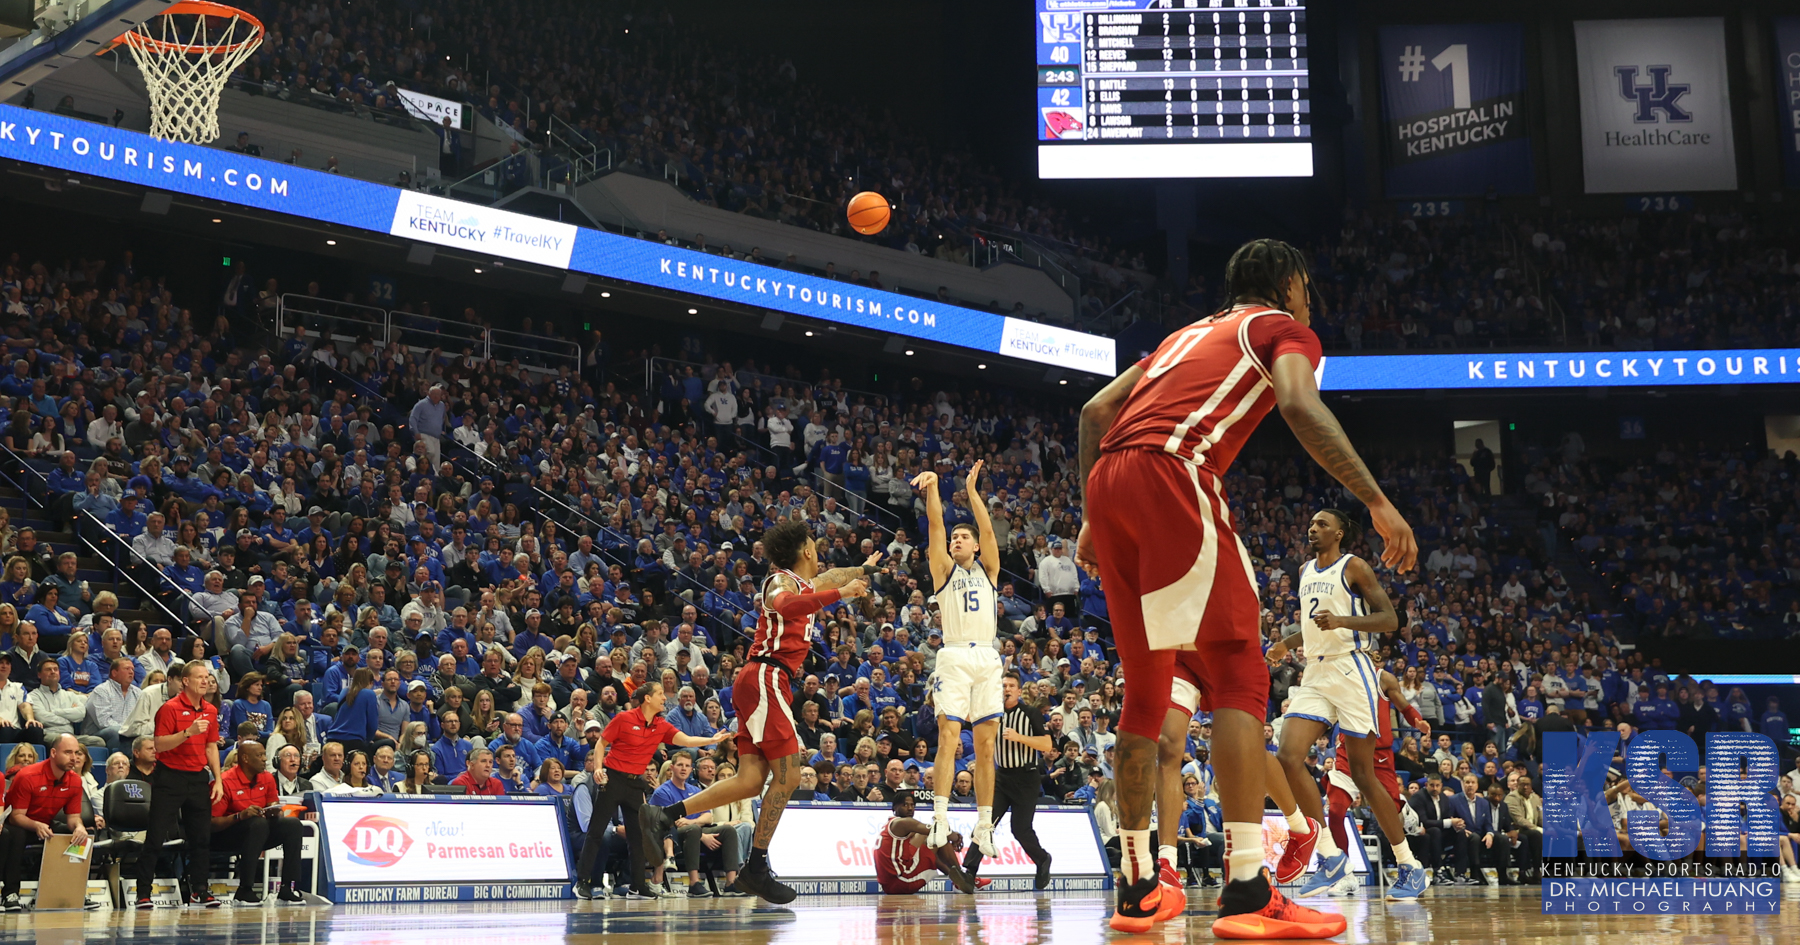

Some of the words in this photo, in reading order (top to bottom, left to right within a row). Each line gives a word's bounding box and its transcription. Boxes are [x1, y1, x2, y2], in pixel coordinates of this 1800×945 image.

[1086, 14, 1094, 26] 0
[1162, 12, 1170, 24] 2
[1212, 12, 1220, 24] 0
[1238, 12, 1246, 24] 0
[1264, 12, 1270, 22] 0
[1086, 26, 1094, 36] 2
[1164, 24, 1170, 36] 7
[1188, 24, 1196, 36] 0
[1238, 24, 1246, 34] 0
[1264, 22, 1270, 34] 0
[1290, 22, 1296, 34] 0
[1086, 38, 1094, 48] 4
[1164, 36, 1170, 48] 2
[1188, 36, 1196, 48] 2
[1214, 36, 1220, 48] 0
[1240, 36, 1246, 46] 0
[1290, 34, 1296, 46] 0
[1050, 46, 1069, 62] 40
[1086, 50, 1096, 60] 12
[1162, 48, 1172, 60] 12
[1214, 48, 1222, 60] 0
[1240, 48, 1246, 60] 0
[1290, 46, 1298, 58] 0
[1086, 62, 1098, 72] 15
[1164, 60, 1172, 72] 2
[1190, 60, 1196, 72] 0
[1214, 60, 1222, 70] 2
[1240, 60, 1248, 70] 0
[1265, 58, 1272, 70] 0
[1046, 70, 1074, 82] 2:43
[1088, 78, 1096, 90] 0
[1162, 78, 1174, 90] 13
[1240, 78, 1248, 89] 0
[1266, 76, 1274, 88] 0
[1398, 44, 1471, 109] #1
[1051, 88, 1070, 106] 42
[1088, 90, 1096, 102] 3
[1164, 90, 1172, 102] 4
[1190, 90, 1198, 102] 0
[1241, 88, 1248, 100] 0
[1292, 88, 1298, 100] 0
[1614, 65, 1693, 124] UK
[1088, 104, 1096, 114] 4
[1166, 102, 1172, 114] 2
[1190, 102, 1198, 114] 0
[1216, 102, 1224, 114] 0
[1242, 102, 1250, 114] 0
[1292, 100, 1300, 112] 0
[1166, 114, 1172, 126] 2
[1216, 114, 1224, 126] 0
[1242, 114, 1250, 126] 0
[1268, 114, 1274, 124] 0
[1294, 112, 1300, 124] 2
[1399, 107, 1490, 140] HOSPITAL
[1494, 101, 1513, 119] IN
[1087, 128, 1098, 138] 24
[1166, 126, 1174, 138] 3
[1192, 126, 1198, 138] 3
[1242, 126, 1250, 138] 0
[1268, 126, 1276, 138] 0
[1294, 124, 1300, 136] 0
[1407, 121, 1508, 156] KENTUCKY
[1605, 129, 1710, 146] HealthCare
[0, 121, 289, 197] KYTOURISM.COM
[416, 204, 454, 223] TEAM
[1412, 202, 1450, 216] 235
[409, 216, 486, 242] KENTUCKY
[493, 225, 563, 251] #TravelKY
[372, 281, 393, 300] 32
[660, 258, 936, 328] KENTUCKYTOURISM.COM
[1014, 328, 1039, 342] TEAM
[1010, 338, 1060, 357] KENTUCKY
[1064, 343, 1110, 362] #TravelKY
[1146, 326, 1214, 378] 0
[1467, 356, 1800, 379] KENTUCKYTOURI
[963, 590, 980, 612] 15
[1309, 597, 1320, 619] 2
[124, 784, 144, 798] UK
[426, 821, 465, 836] New!
[354, 826, 404, 857] DQ
[427, 842, 504, 858] Parmesan
[510, 841, 553, 858] Garlic
[820, 882, 838, 893] FARM
[840, 881, 867, 892] BUREAU
[992, 880, 1008, 890] FARM
[1010, 880, 1034, 890] BUREAU
[1054, 879, 1064, 889] ON
[1064, 879, 1104, 889] COMMITMENT
[345, 888, 394, 902] KENTUCKY
[396, 887, 420, 901] FARM
[424, 886, 458, 900] BUREAU
[474, 886, 488, 899] BIG
[491, 886, 503, 899] ON
[506, 886, 564, 899] COMMITMENT
